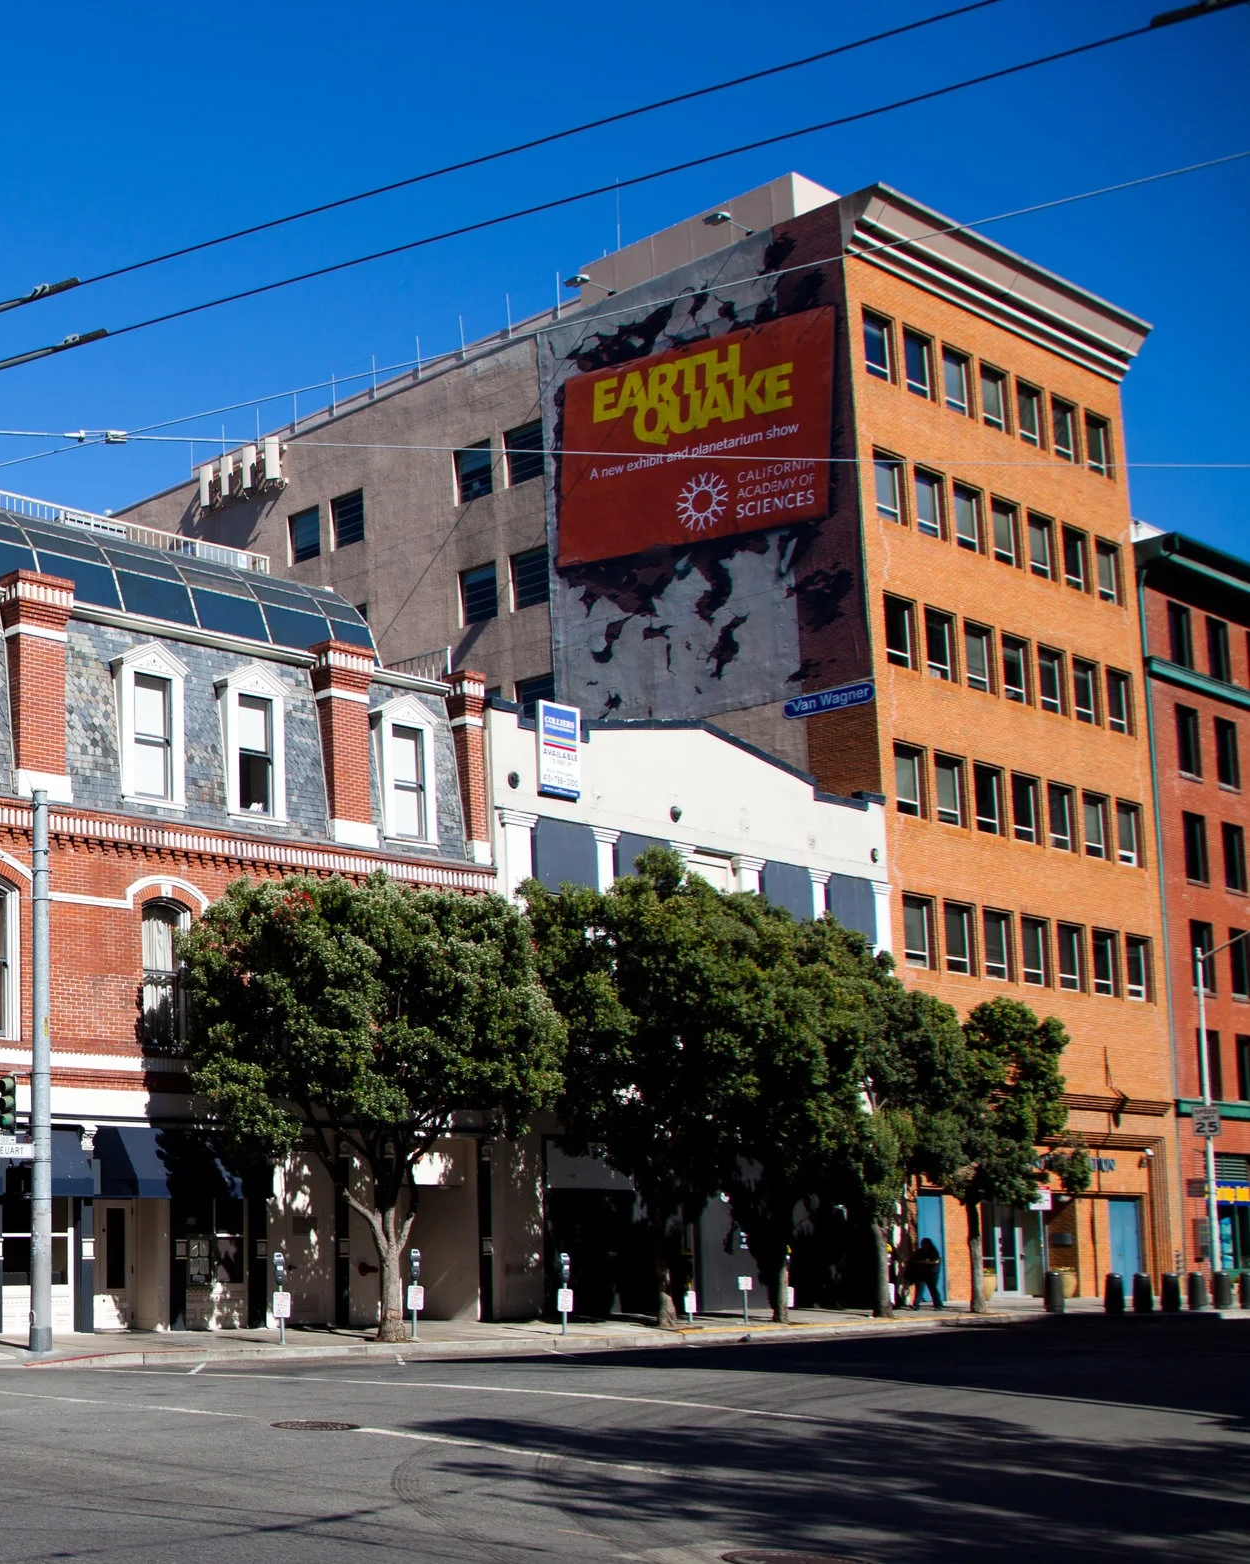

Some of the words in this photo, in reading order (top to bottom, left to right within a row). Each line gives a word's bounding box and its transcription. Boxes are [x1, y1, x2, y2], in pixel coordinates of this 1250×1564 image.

[593, 343, 741, 423] EARTH
[632, 362, 793, 445] QUAKE
[590, 467, 598, 480] A
[601, 464, 624, 478] new
[627, 454, 664, 472] exhibit
[666, 446, 689, 463] and
[691, 431, 764, 458] planetarium
[765, 422, 800, 440] show
[737, 457, 816, 484] CALIFORNIA
[736, 478, 797, 500] ACADEMY
[799, 473, 816, 486] OF
[735, 490, 816, 518] SCIENCES
[791, 699, 817, 712] Van
[819, 687, 869, 705] Wagner
[544, 715, 575, 730] COLLIERS
[543, 748, 578, 762] AVAILABLE
[1195, 1122, 1218, 1133] 25
